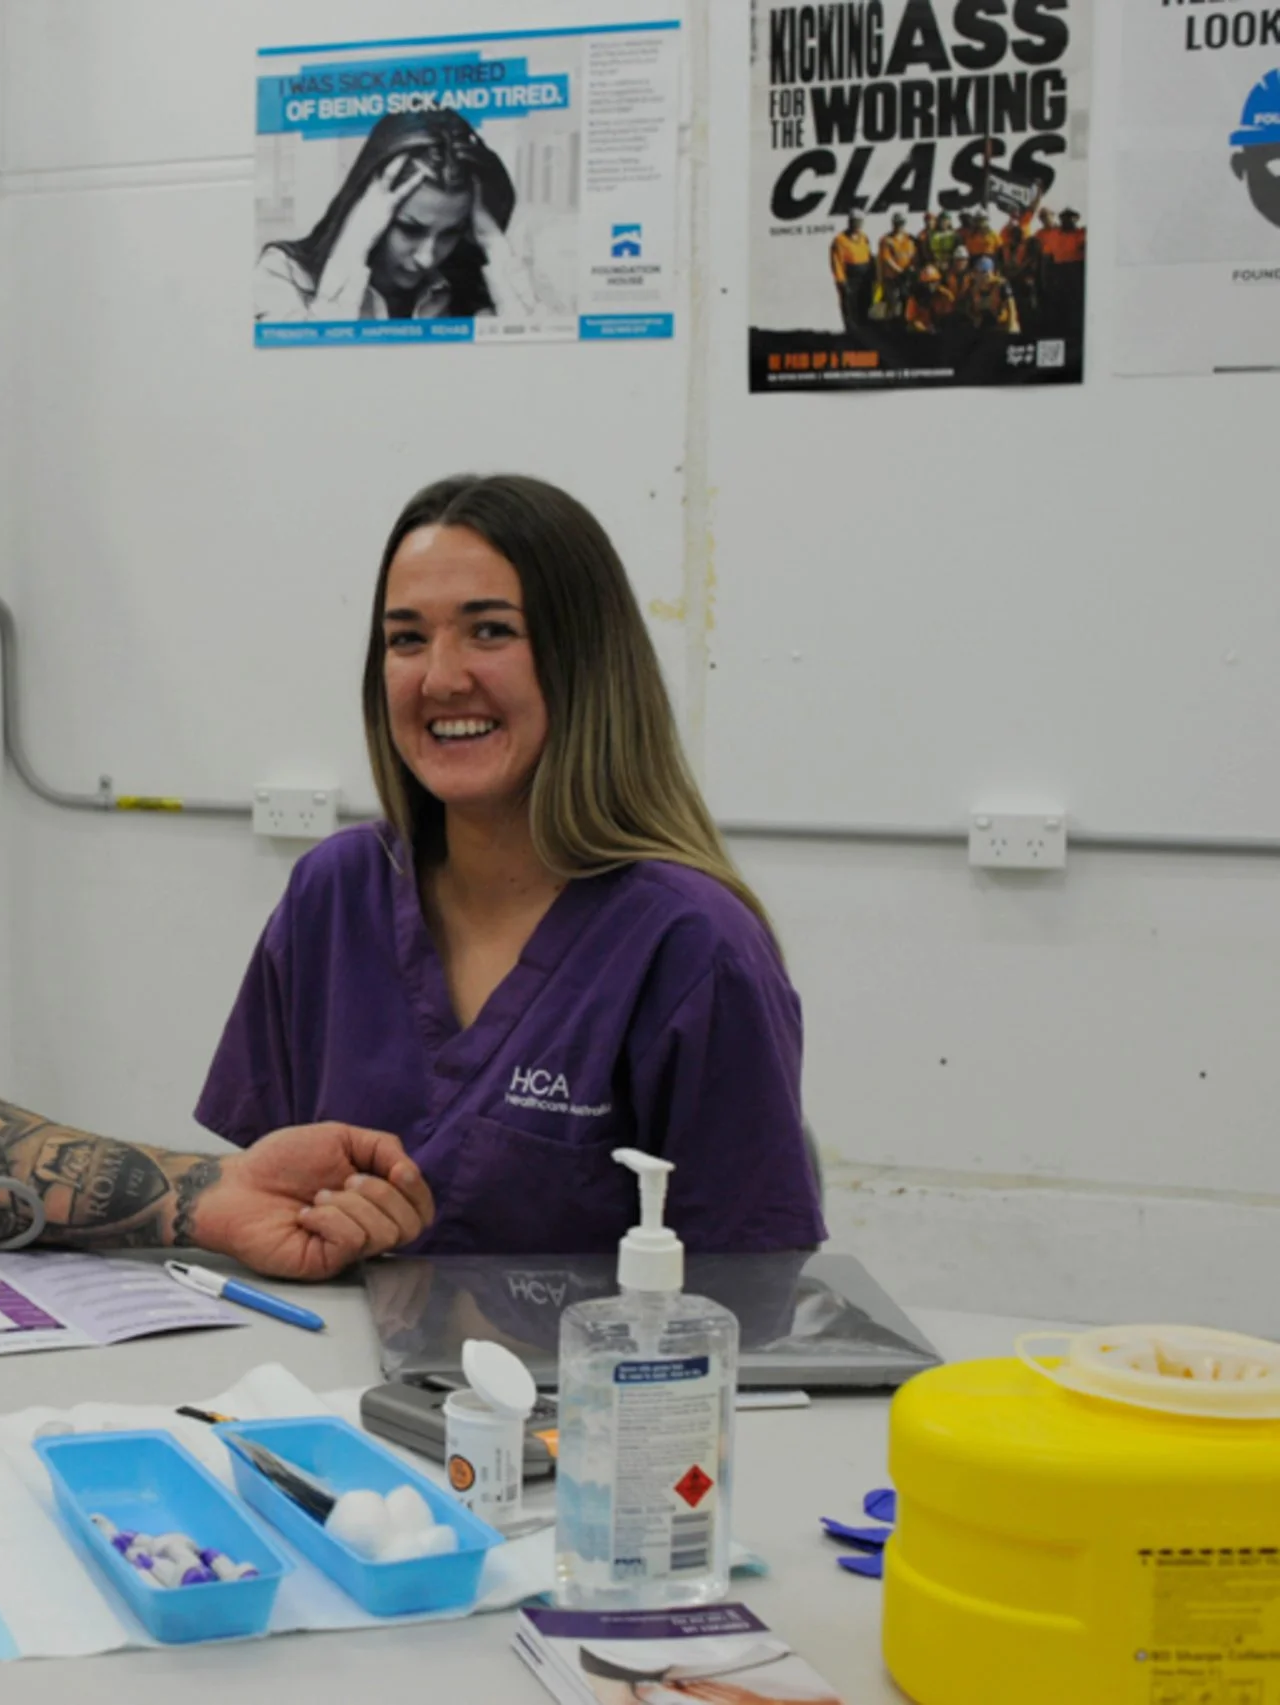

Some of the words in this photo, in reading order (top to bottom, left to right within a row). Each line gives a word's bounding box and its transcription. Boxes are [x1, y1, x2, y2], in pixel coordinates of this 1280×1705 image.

[770, 0, 884, 86] KICKING
[885, 0, 1069, 75] ASS
[289, 75, 334, 96] WAS
[338, 71, 387, 93] SICK
[389, 67, 438, 88] AND
[447, 61, 506, 85] TIRED
[285, 100, 315, 122] OF
[320, 94, 383, 119] BEING
[386, 90, 438, 114] SICK
[439, 87, 490, 110] AND
[492, 83, 563, 107] TIRED.
[769, 87, 806, 119] FOR
[809, 68, 1067, 146] WORKING
[771, 118, 805, 150] THE
[770, 132, 1067, 221] CLASS
[509, 1065, 570, 1099] HCA
